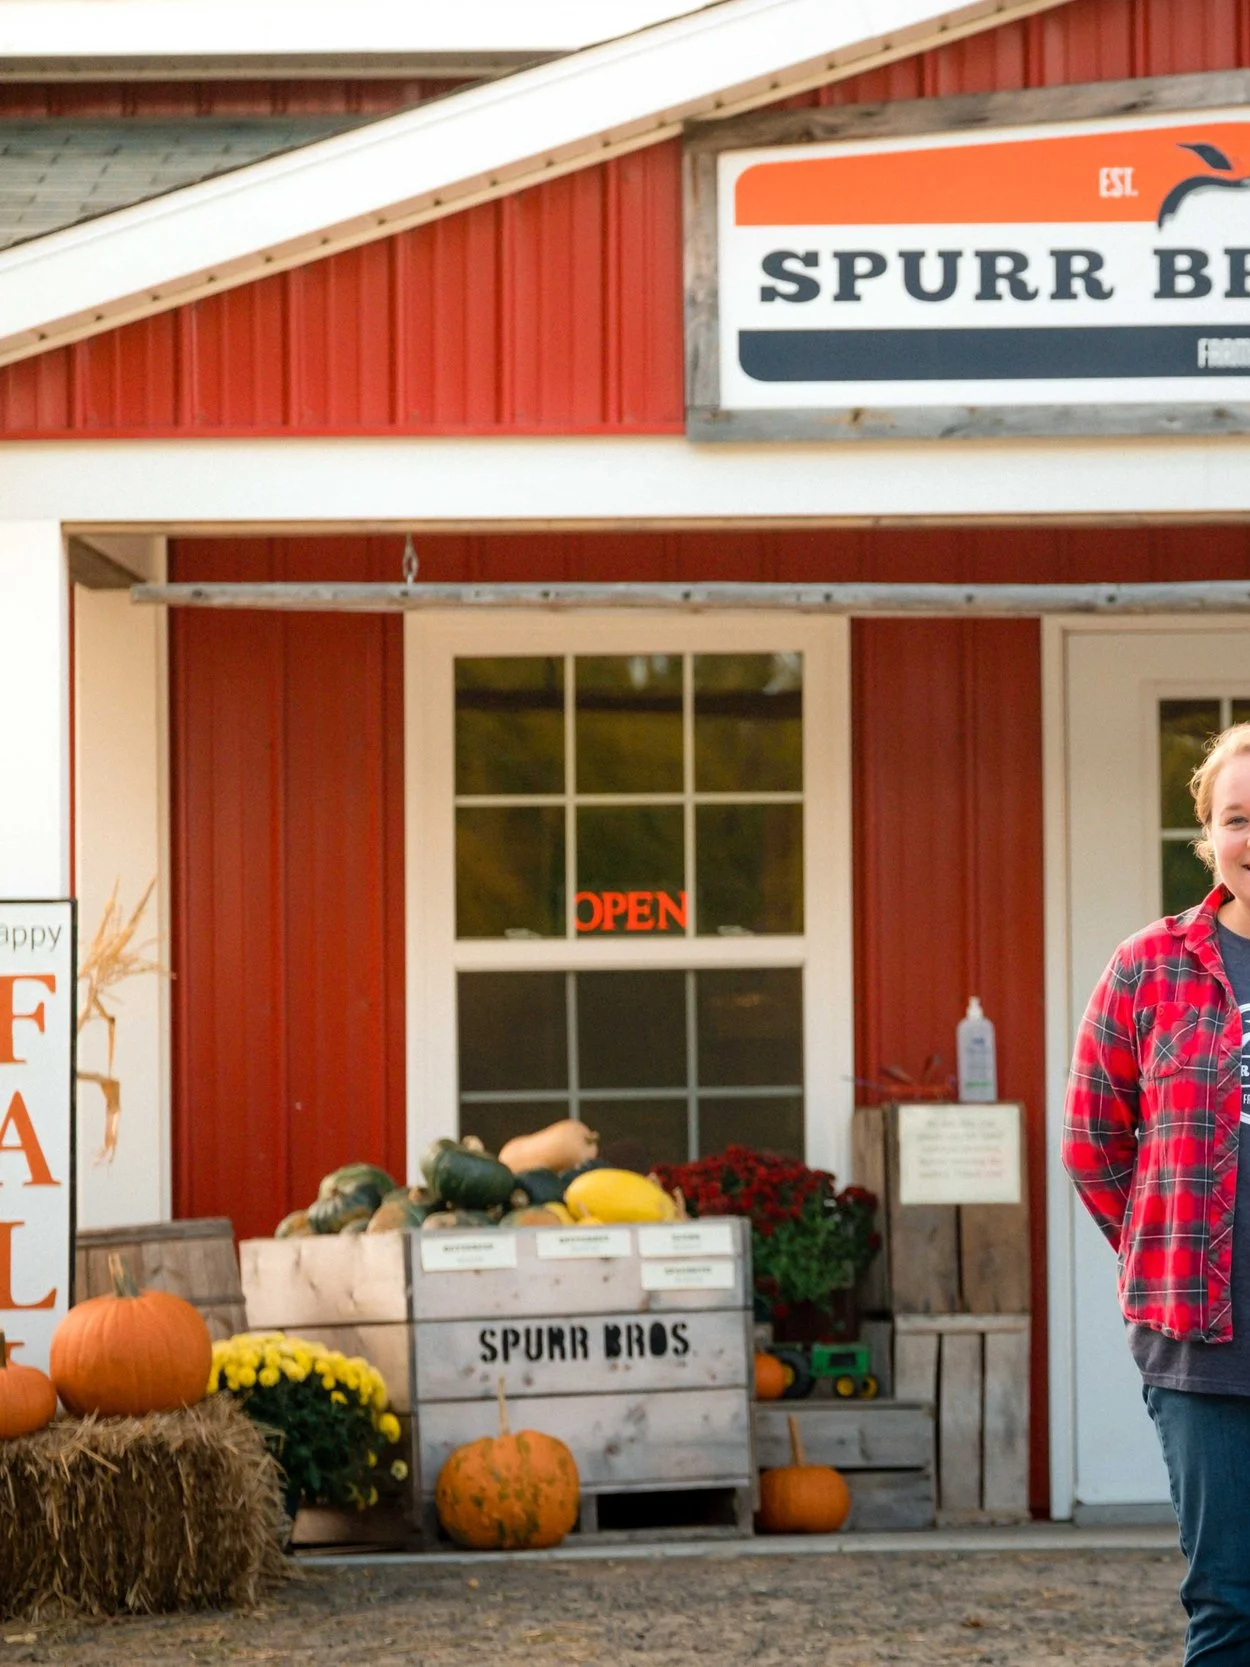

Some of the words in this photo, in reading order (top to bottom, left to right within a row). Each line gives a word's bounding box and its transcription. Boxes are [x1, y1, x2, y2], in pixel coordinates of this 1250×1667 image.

[1098, 166, 1139, 198] EST.
[760, 248, 1115, 303] SPURR
[574, 889, 689, 932] OPEN
[0, 973, 62, 1370] FAL
[479, 1321, 589, 1363] SPURR
[604, 1321, 691, 1360] BROS
